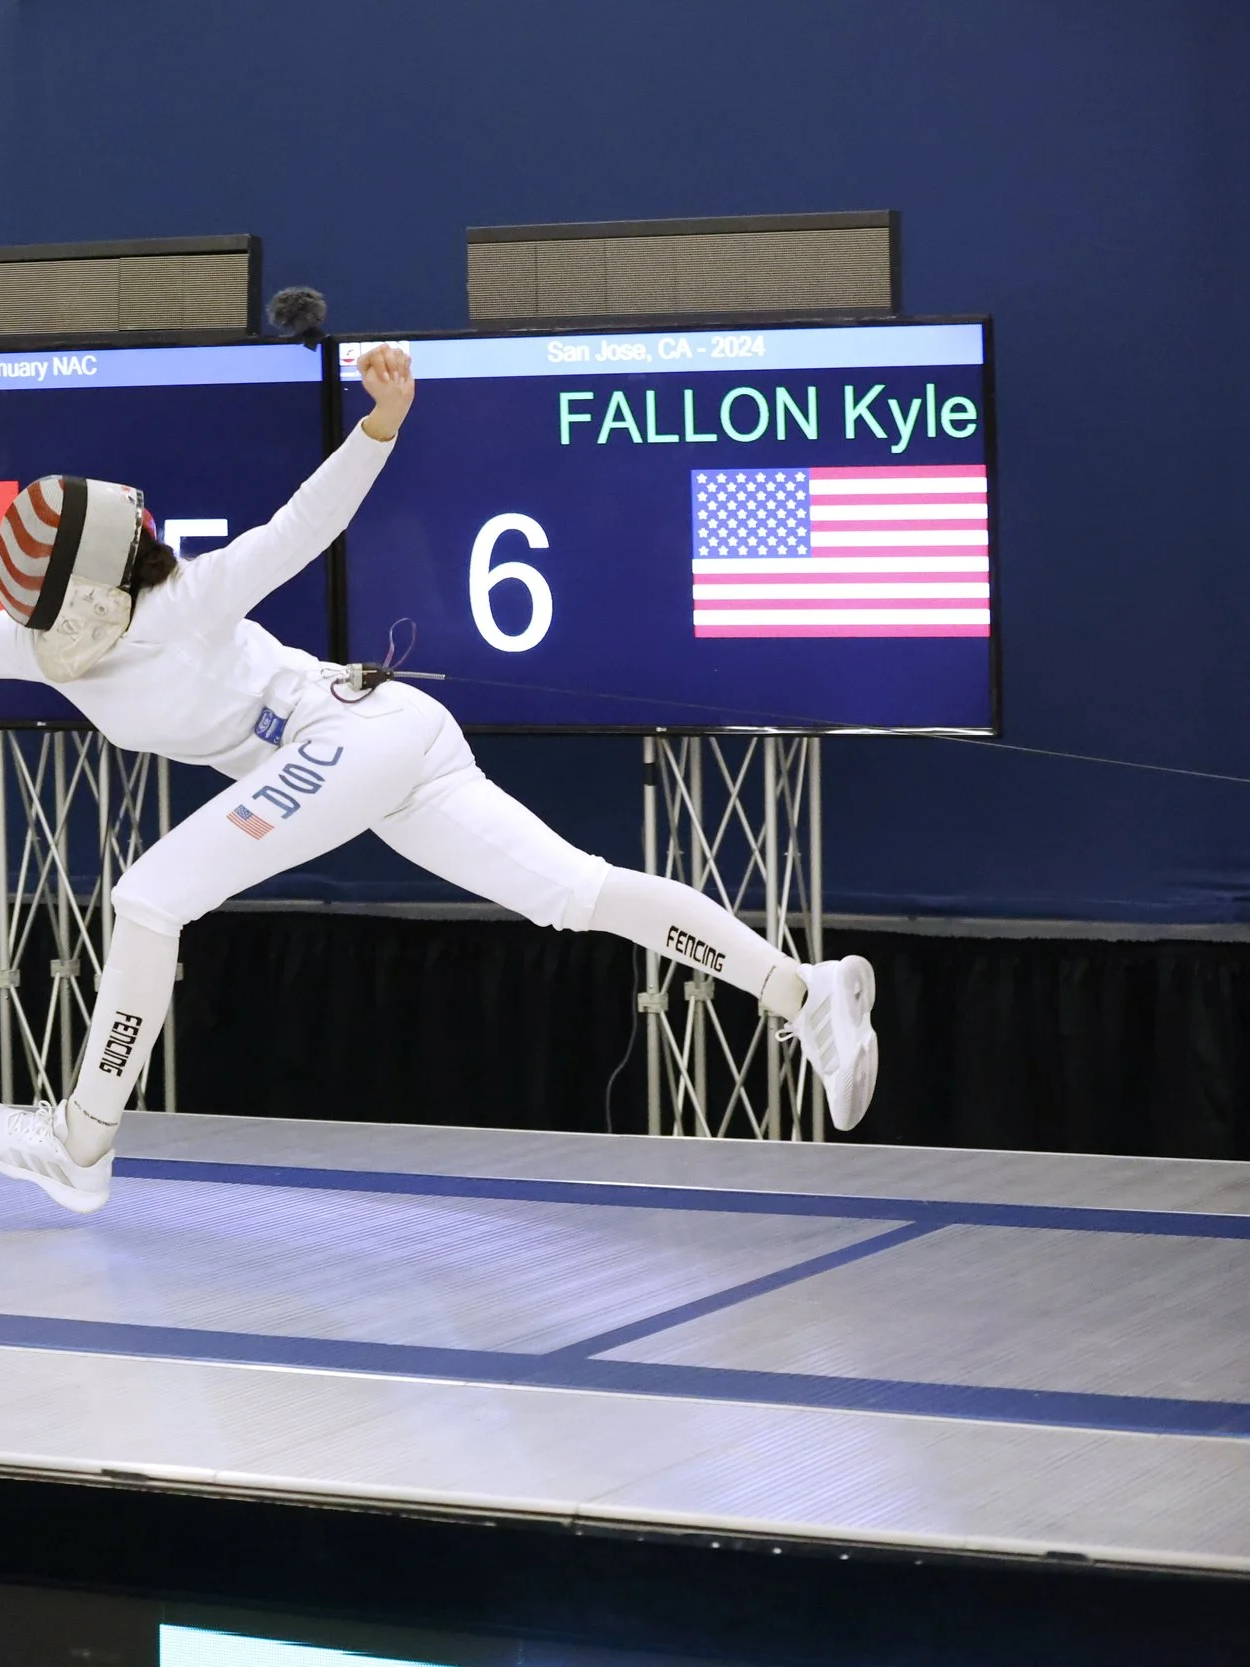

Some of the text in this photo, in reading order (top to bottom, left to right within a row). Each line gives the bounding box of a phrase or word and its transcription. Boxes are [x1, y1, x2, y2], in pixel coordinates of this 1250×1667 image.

[53, 354, 98, 376] NAC
[547, 341, 590, 363] San
[595, 340, 653, 363] Jose,
[658, 337, 693, 360] CA
[710, 335, 766, 358] 2024
[559, 383, 979, 454] FALLON Kyle
[468, 512, 554, 653] 6
[666, 925, 726, 973] FENCING
[99, 1011, 143, 1077] FENCING
